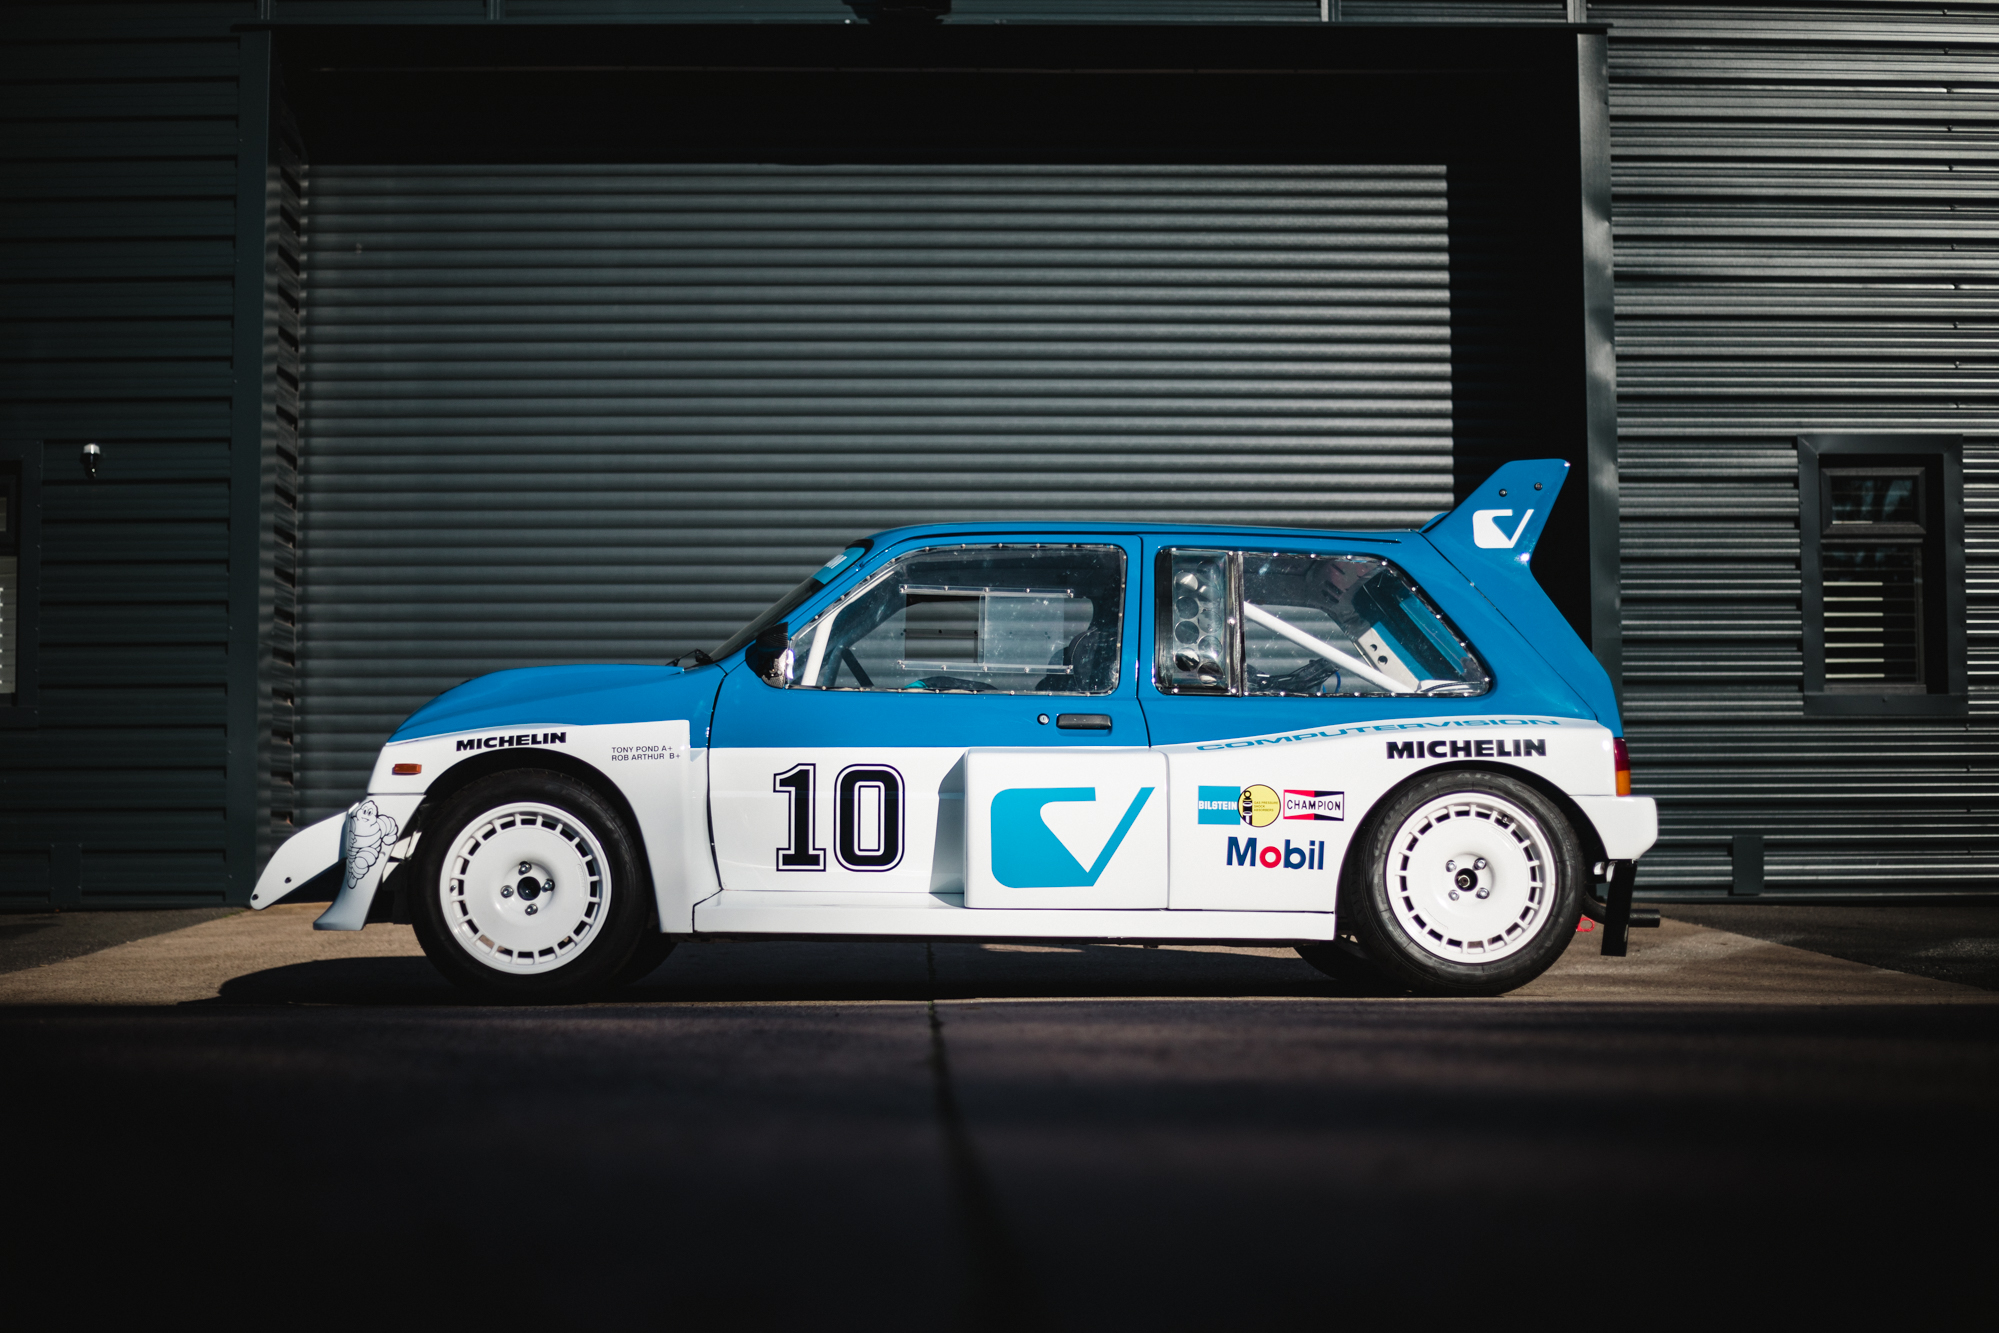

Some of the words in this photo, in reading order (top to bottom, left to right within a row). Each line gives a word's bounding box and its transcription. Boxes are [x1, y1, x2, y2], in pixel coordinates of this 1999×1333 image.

[456, 732, 566, 751] MICHELIN
[1196, 719, 1561, 751] COMPUTERVISION
[611, 746, 634, 754] TONY
[636, 745, 659, 753] POND
[611, 754, 629, 762] ROB
[631, 753, 665, 761] ARTHUR
[669, 752, 681, 760] B+
[1386, 739, 1547, 759] MICHELIN
[1198, 800, 1238, 811] BILSTEIN
[1286, 799, 1341, 811] CHAMPION
[773, 763, 905, 872] 10
[1226, 836, 1325, 871] Mobil
